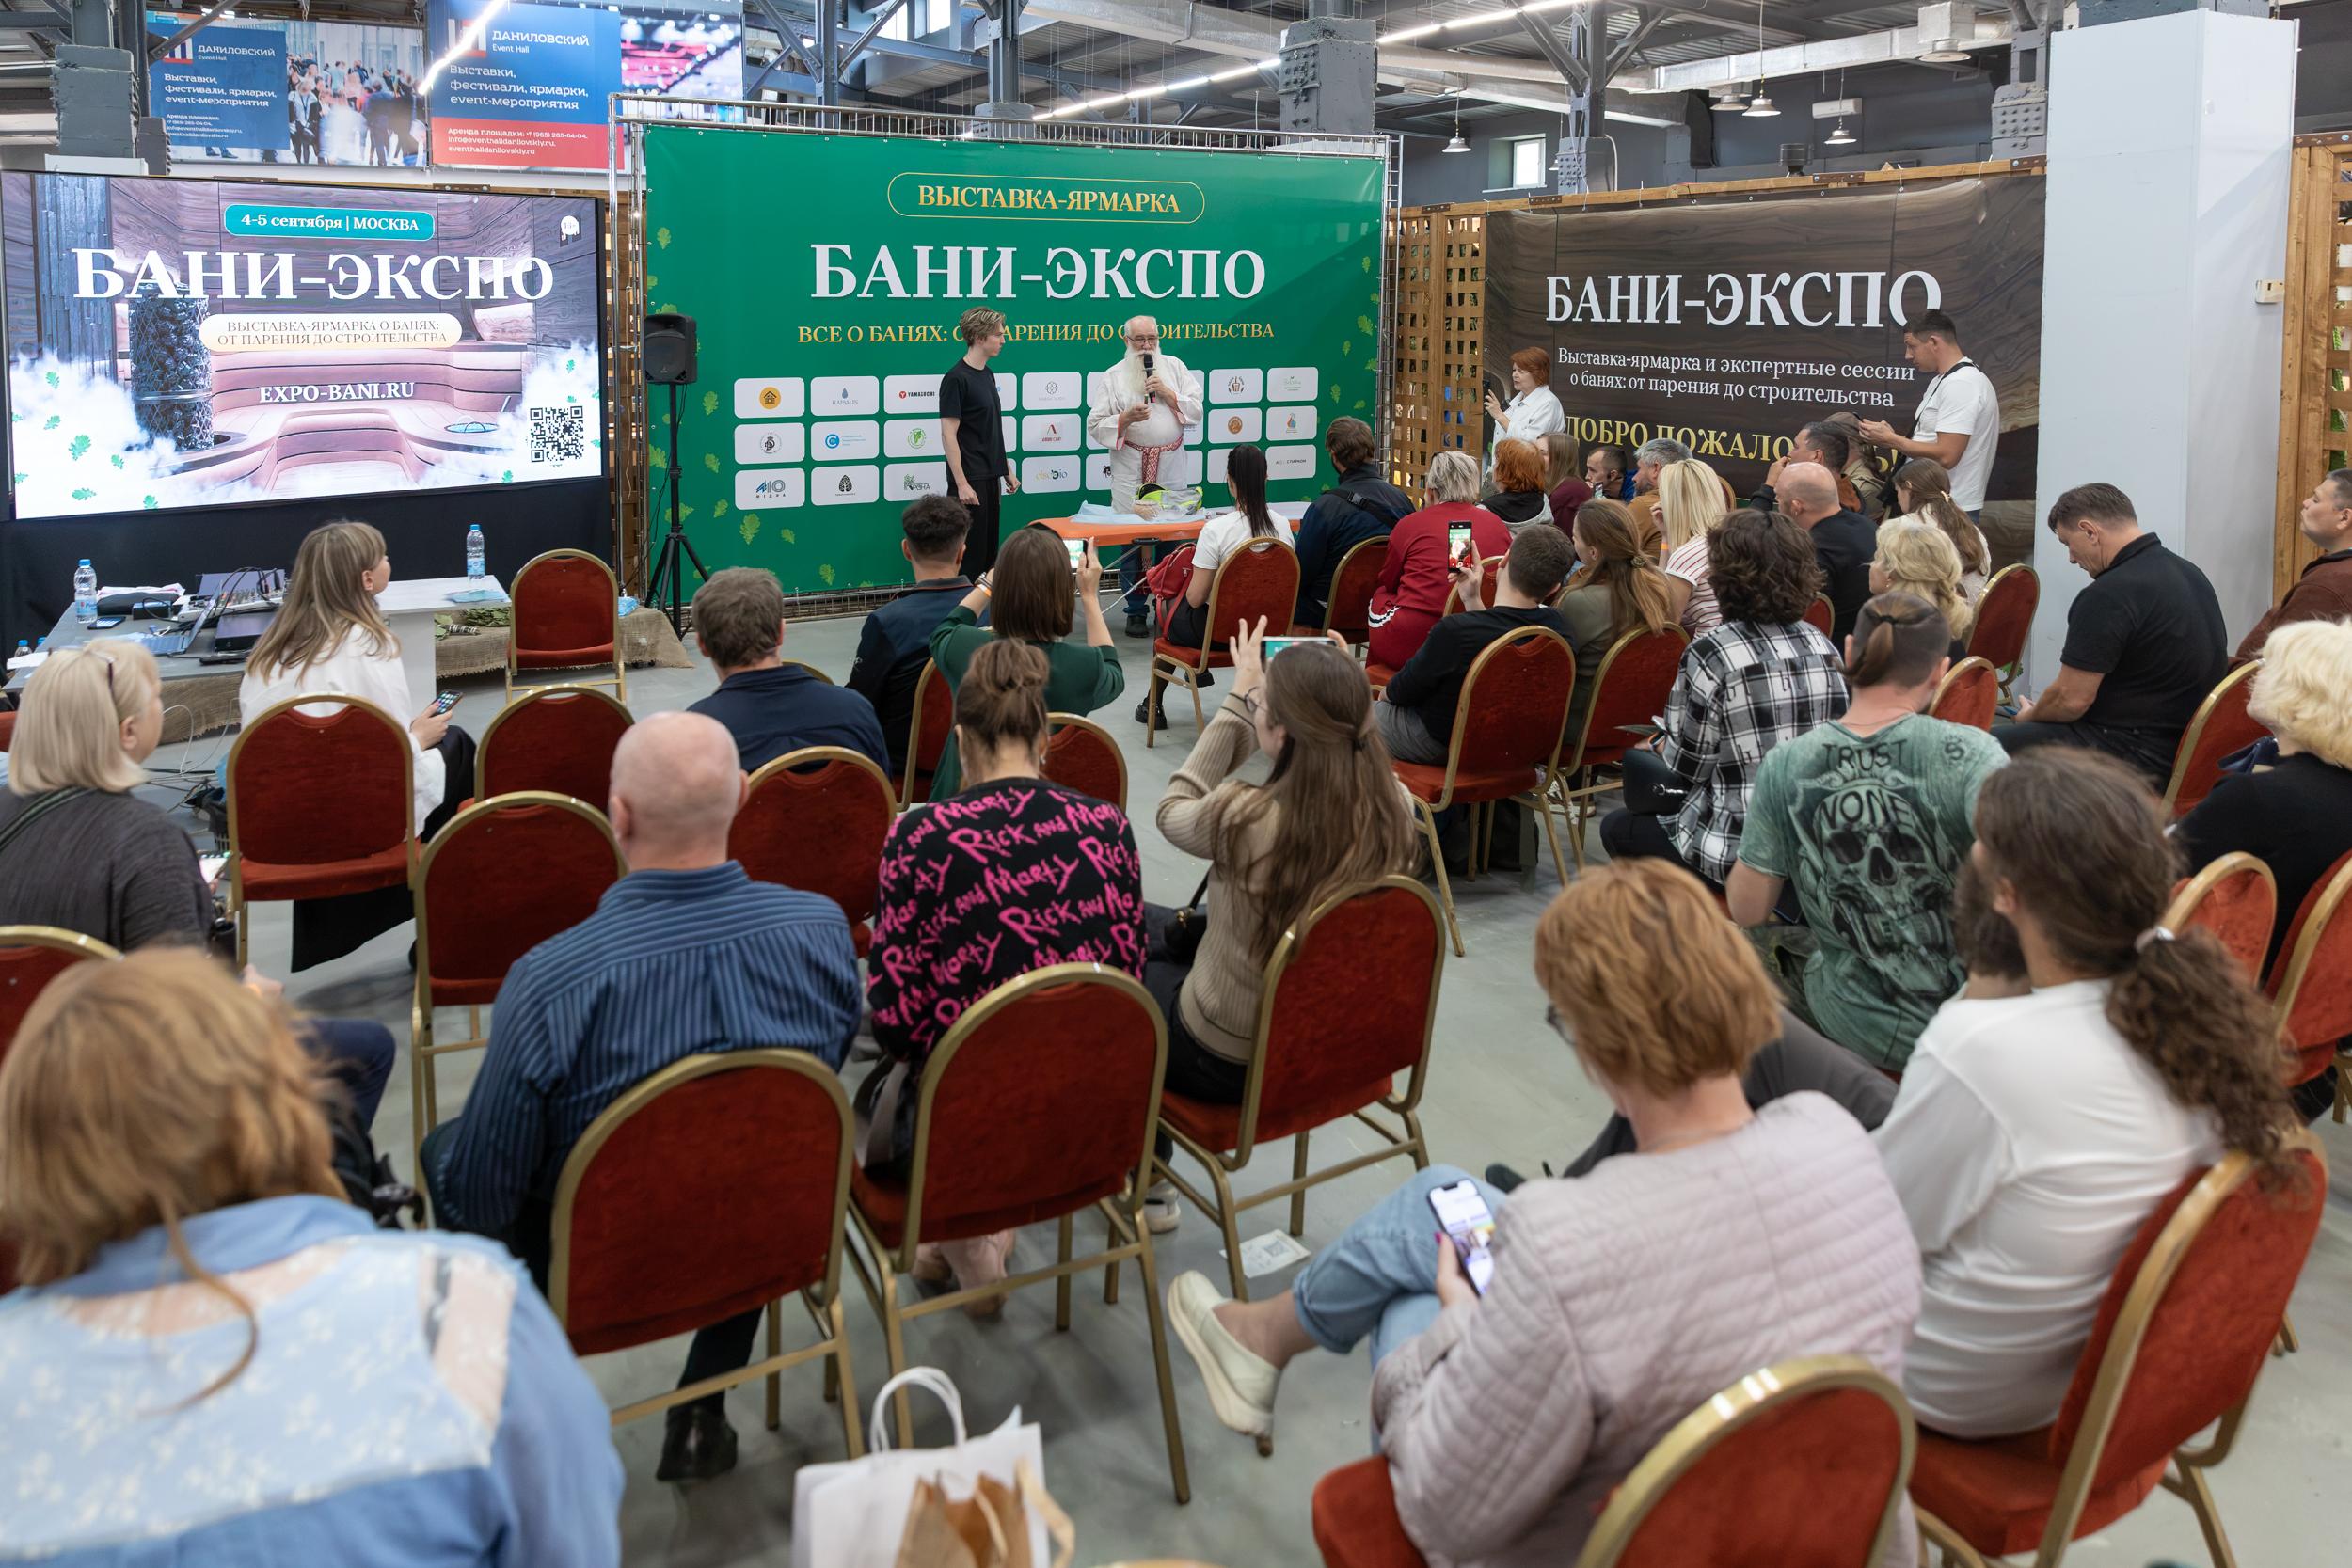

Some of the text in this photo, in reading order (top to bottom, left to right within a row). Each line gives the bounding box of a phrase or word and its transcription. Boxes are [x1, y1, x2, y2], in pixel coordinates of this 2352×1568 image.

[492, 30, 590, 47] ДАНИЛОВСКИЙ
[493, 44, 530, 54] Event Hall
[198, 44, 276, 57] ДАНИЛОВСКИЙ
[164, 73, 218, 84] Выставки,
[450, 64, 516, 78] Выставки,
[165, 85, 278, 99] фестивали, ярмарки,
[450, 79, 589, 98] фестивали, ярмарки,
[165, 96, 269, 107] event-мероприятия
[450, 95, 580, 110] event-мероприятия
[917, 184, 1181, 214] ВЫСТАВКА-ЯРМАРКА
[241, 214, 268, 227] 4-5
[270, 214, 342, 231] сентября
[353, 217, 420, 231] МОСКВА
[71, 247, 554, 301] БАНИ-ЭКСПО
[810, 243, 1266, 299] БАНИ-ЭКСПО
[1546, 269, 1943, 328] БАНИ-ЭКСПО
[227, 320, 440, 333] ВЫСТАВКА-ЯРМАРКА О БАНЯХ:
[798, 325, 843, 343] ВСЕ
[847, 325, 864, 342] О
[868, 325, 948, 343] БАНЯХ:
[1002, 324, 1082, 341] АРЕНИЯ
[1086, 324, 1115, 344] ДО
[1118, 323, 1275, 340] СОИТЕЛЬСТВА
[217, 332, 448, 346] ОТ ПАРЕНИЯ ДО СТРОИТЕЛЬСТВА
[1558, 347, 1915, 381] Выставка-ярмарка и экспертные сессии
[258, 381, 416, 404] EXPO-BANI.RU
[1570, 370, 1896, 407] о банях: от парения до строительства
[1565, 416, 1649, 449] ДОБРО
[1821, 738, 1908, 771] TRUST
[933, 786, 1036, 831] Morty
[1820, 789, 1914, 832] NONE
[947, 823, 1038, 865] Rick
[983, 863, 1079, 907] Morty
[998, 898, 1082, 946] Rick
